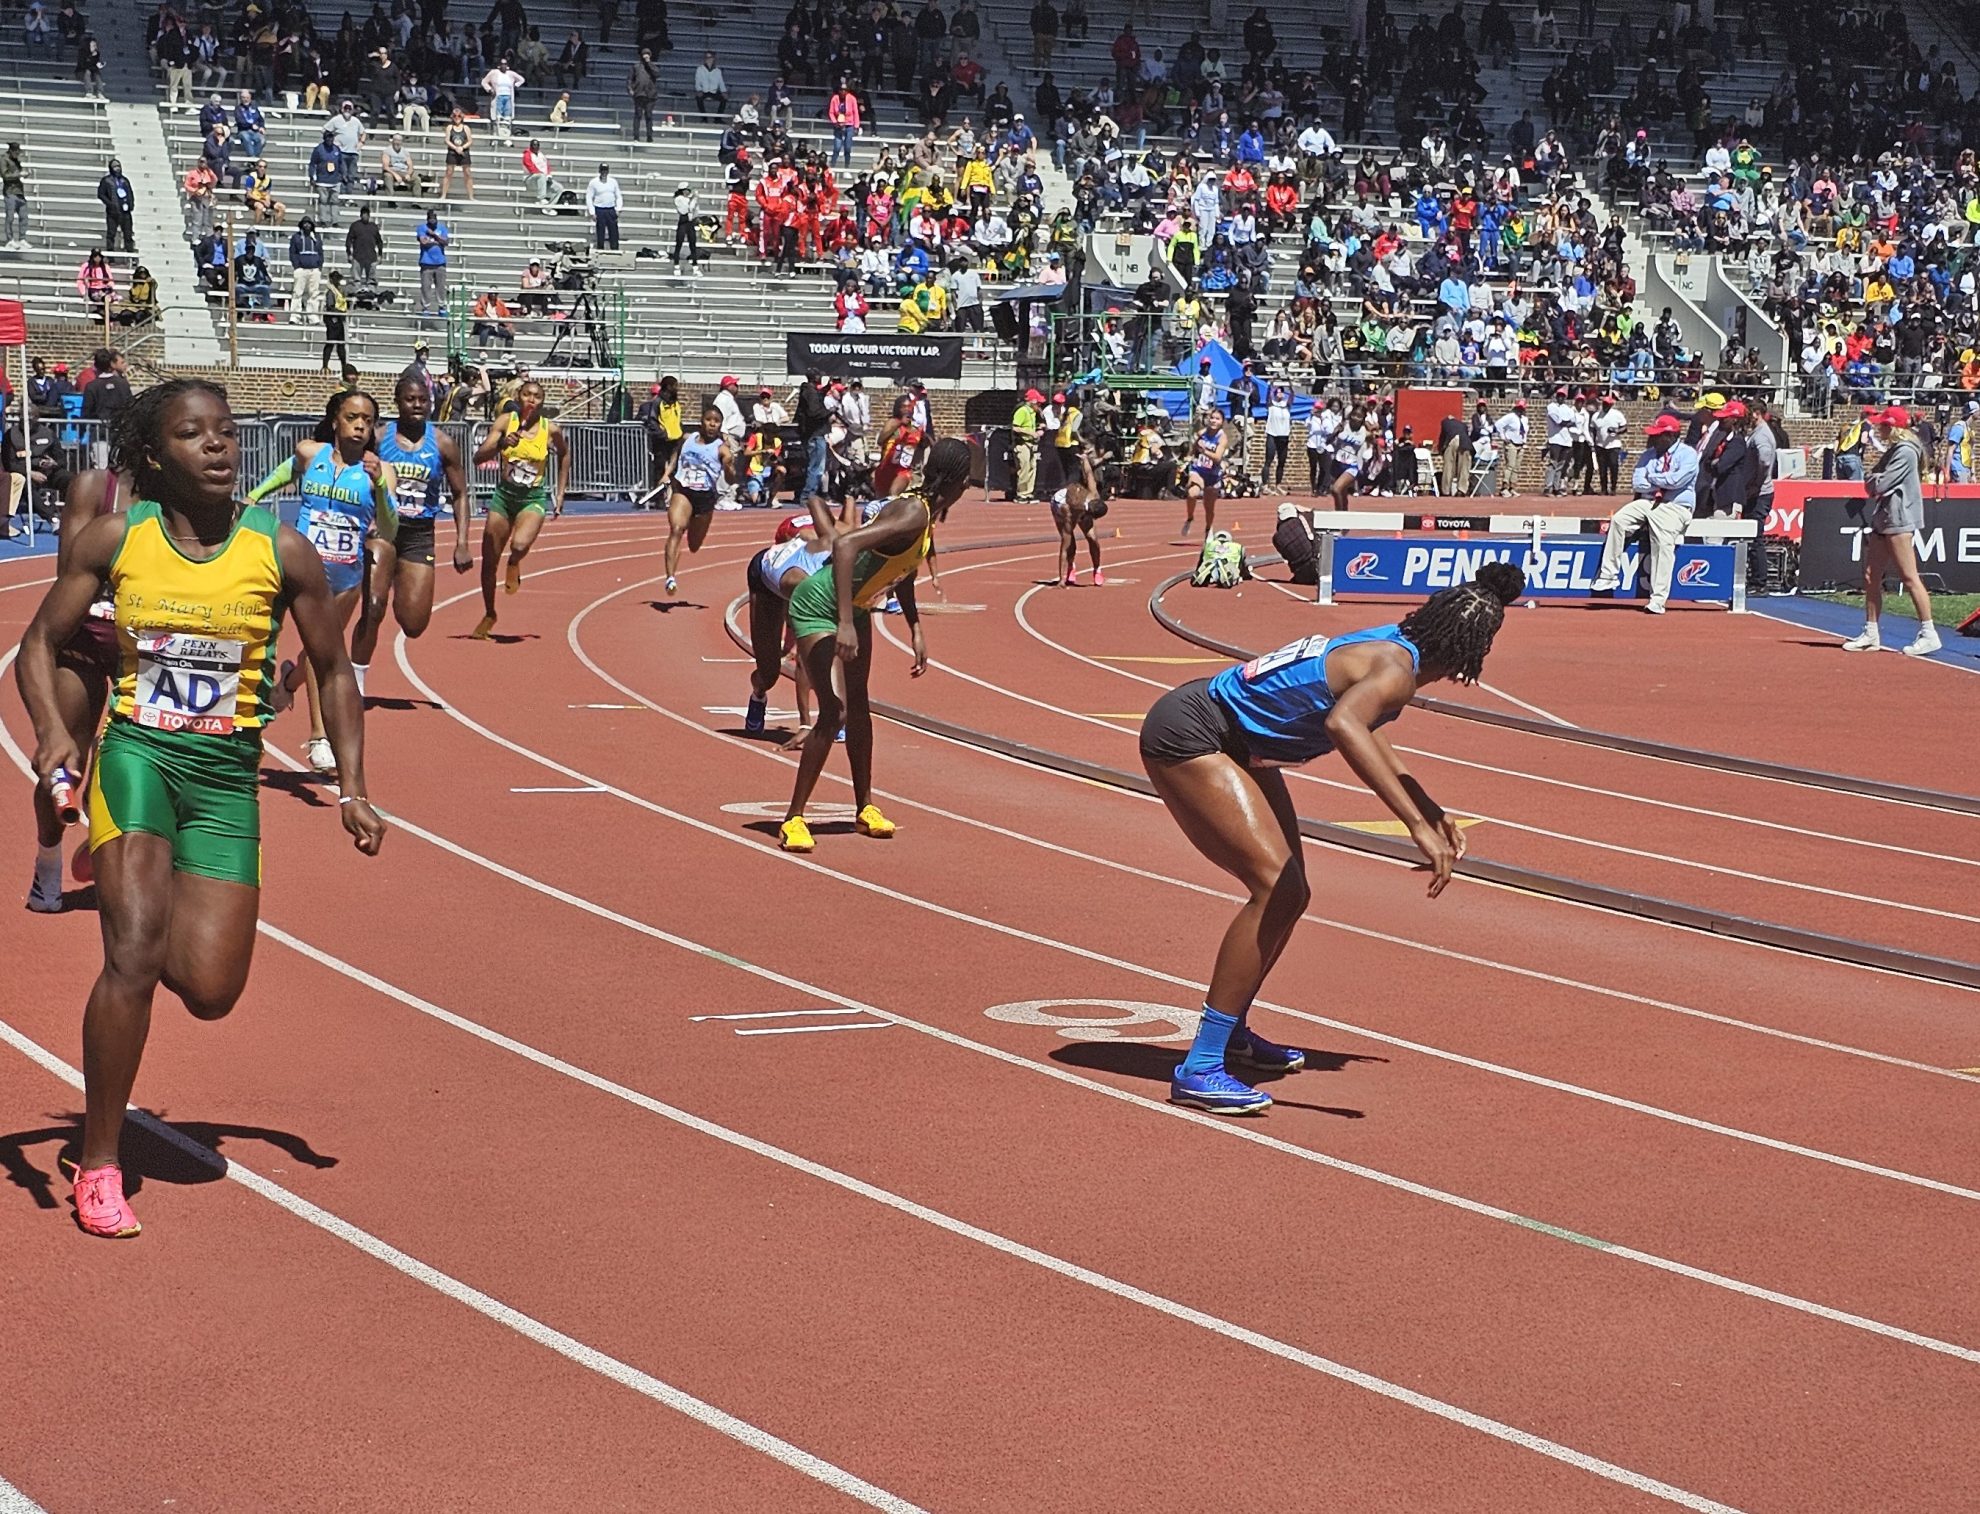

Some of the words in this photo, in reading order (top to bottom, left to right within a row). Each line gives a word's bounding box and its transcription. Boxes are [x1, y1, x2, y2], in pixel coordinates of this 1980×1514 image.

[1126, 263, 1139, 273] NB
[1682, 281, 1694, 290] NC
[809, 343, 841, 354] TODAY
[841, 343, 851, 354] IS
[851, 344, 878, 355] YOUR
[879, 345, 919, 356] VICTORY
[920, 346, 940, 356] LAP.
[1437, 519, 1471, 528] TOYOTA
[1840, 527, 1980, 562] TME
[1521, 550, 1651, 591] RELY
[127, 593, 145, 609] St.
[153, 598, 213, 622] Mary
[221, 600, 263, 621] High
[182, 638, 218, 650] PENN
[179, 647, 229, 660] RELAYS
[147, 668, 222, 714] AD
[162, 714, 223, 731] TOYOTA
